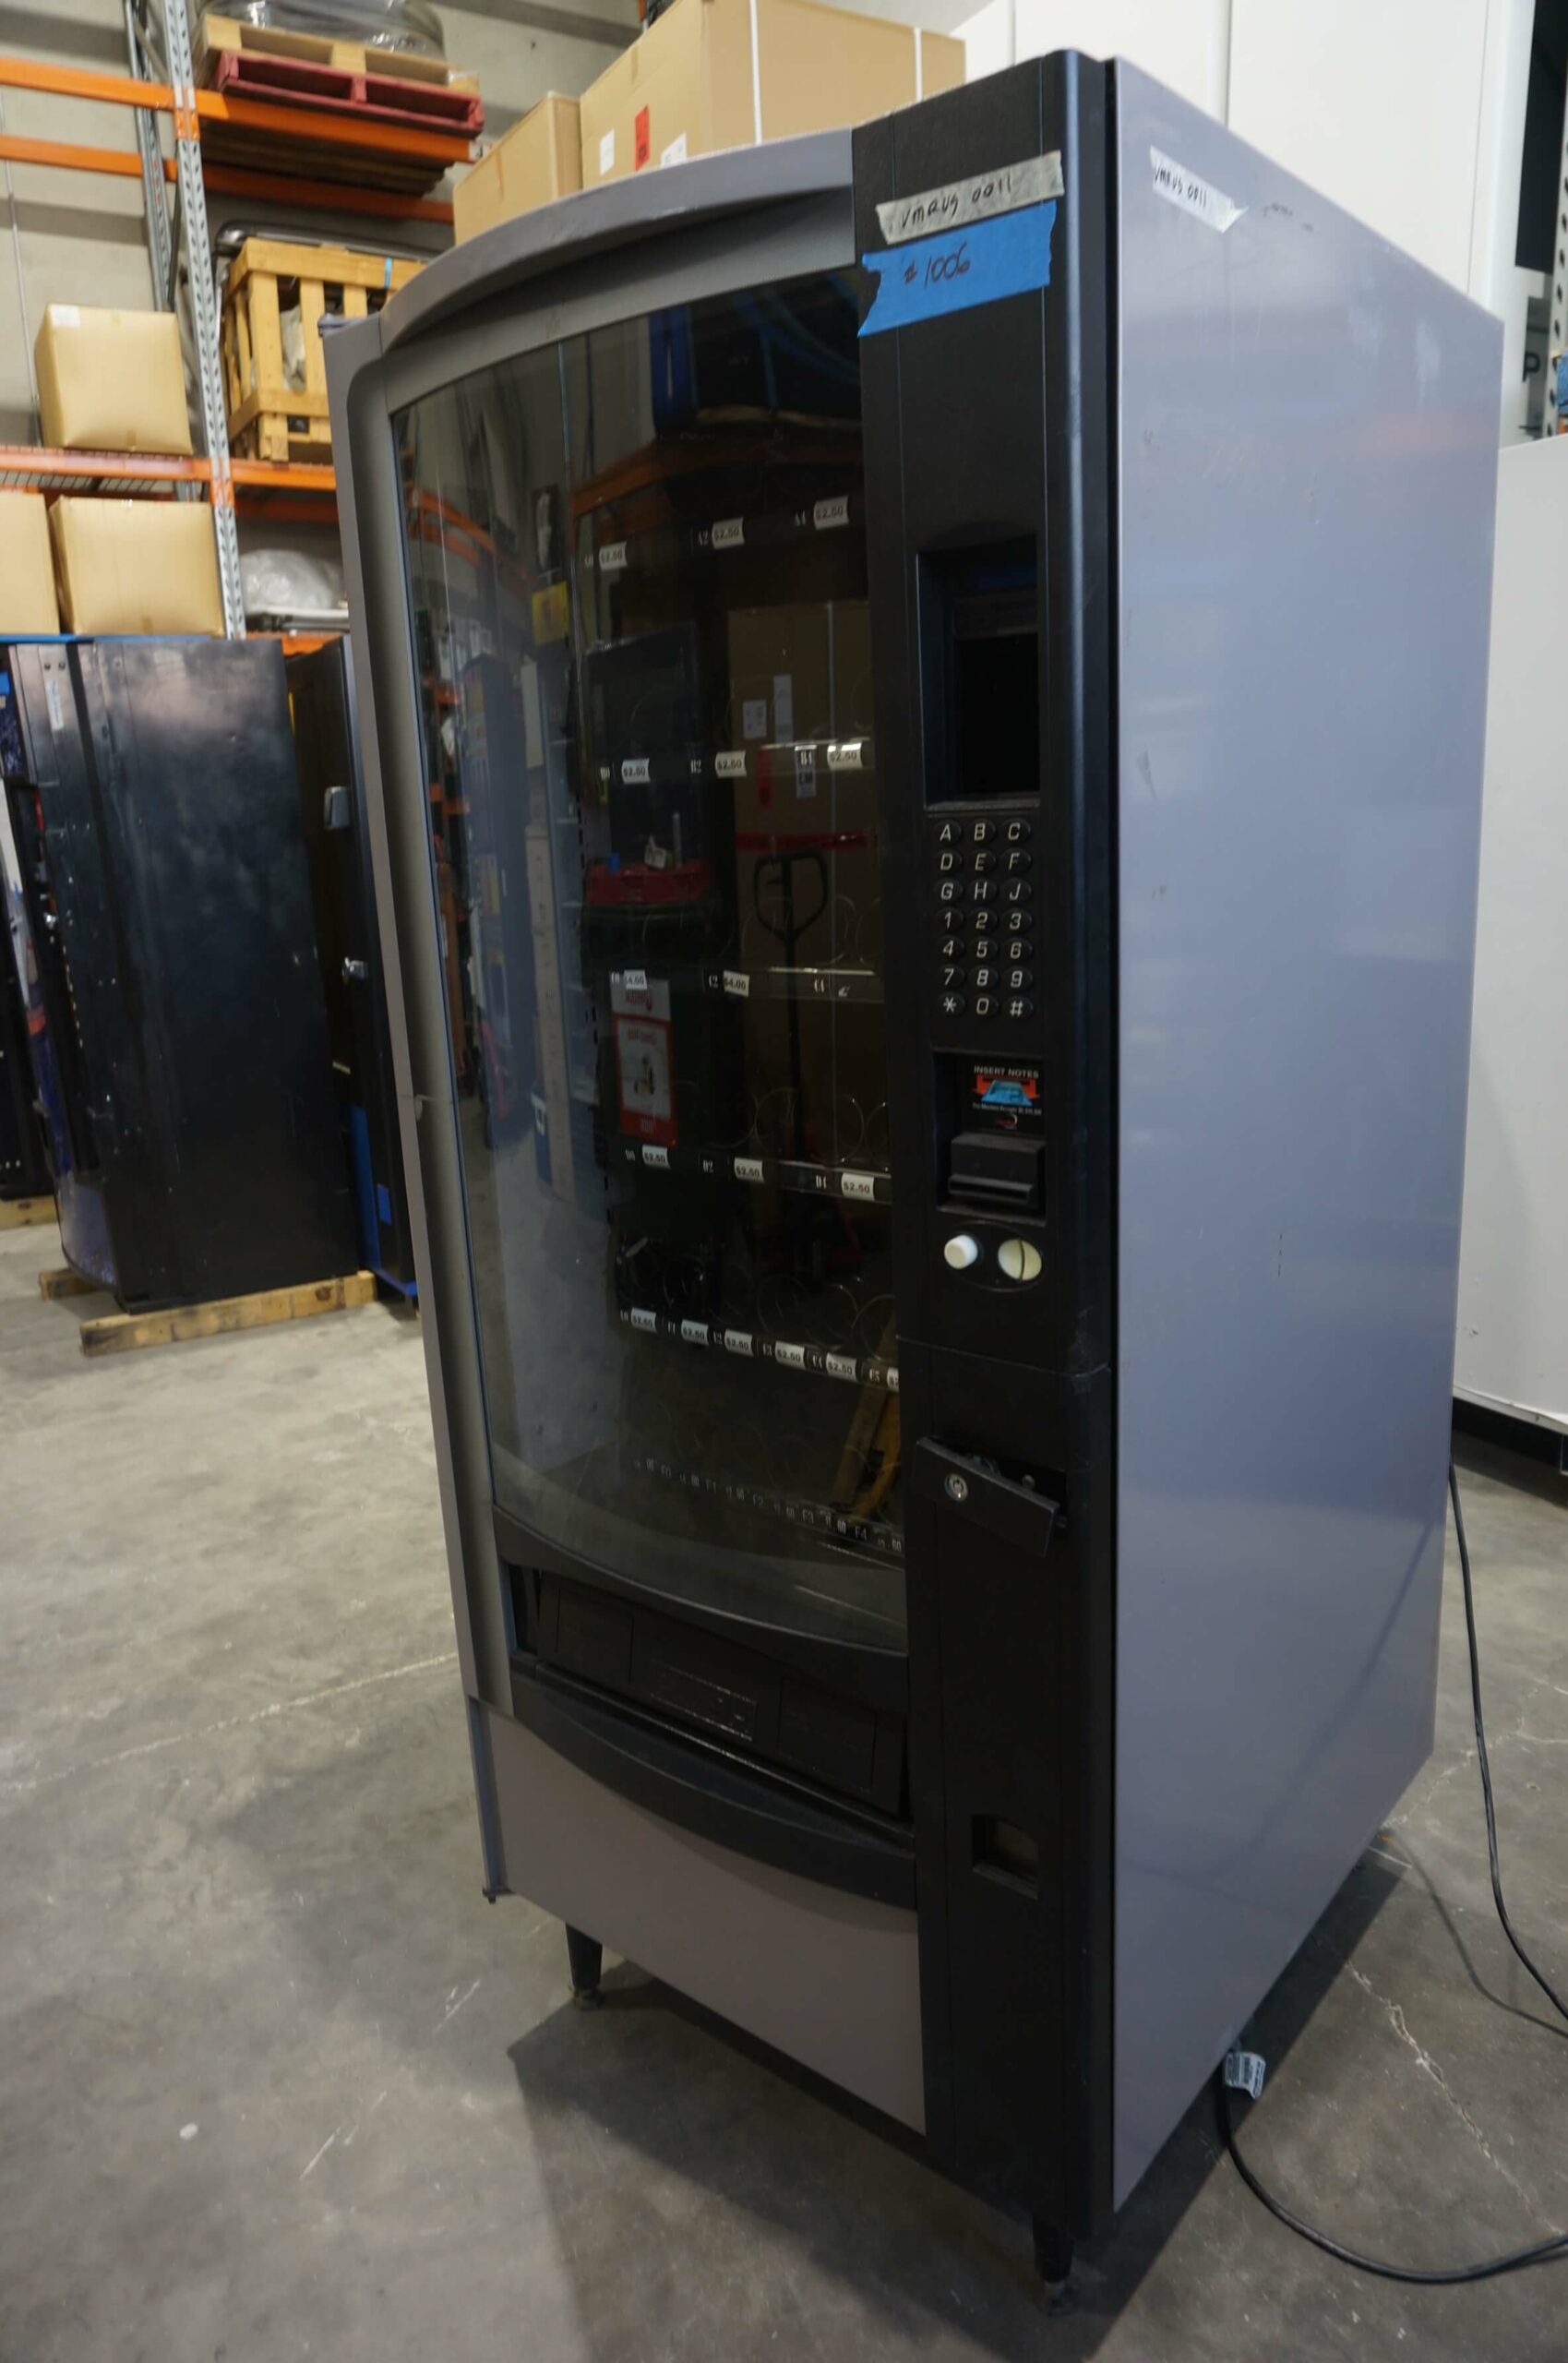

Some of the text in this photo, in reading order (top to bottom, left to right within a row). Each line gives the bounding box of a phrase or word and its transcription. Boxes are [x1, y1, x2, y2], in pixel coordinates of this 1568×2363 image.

[940, 822, 1021, 841] A B C
[940, 852, 1021, 870] D E F
[940, 882, 1022, 901] G H J
[943, 912, 1022, 930] 1 2 3
[943, 941, 1023, 958] 4 5 6
[944, 968, 1023, 988] 7 8 9
[1010, 1000, 1023, 1017] #
[974, 1065, 1039, 1079] INSERT NOTES
